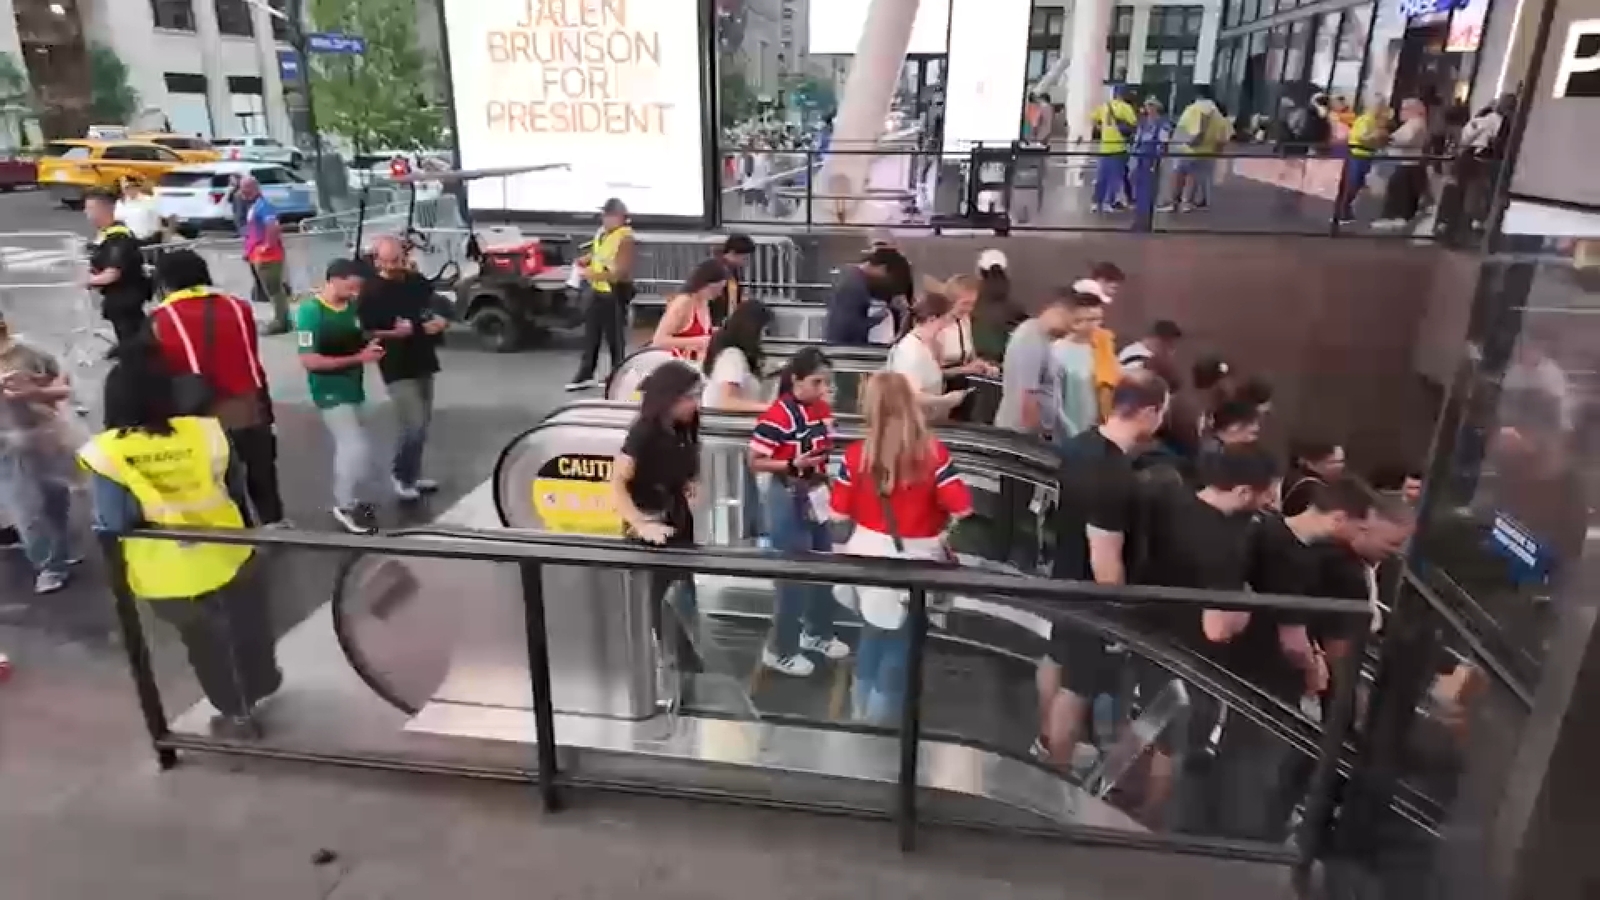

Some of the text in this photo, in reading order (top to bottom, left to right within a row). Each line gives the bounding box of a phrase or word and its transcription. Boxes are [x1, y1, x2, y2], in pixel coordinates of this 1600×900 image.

[517, 0, 626, 28] JALEN
[487, 31, 661, 66] BRUNSON
[542, 66, 611, 98] FOR
[486, 101, 675, 134] PRESIDENT
